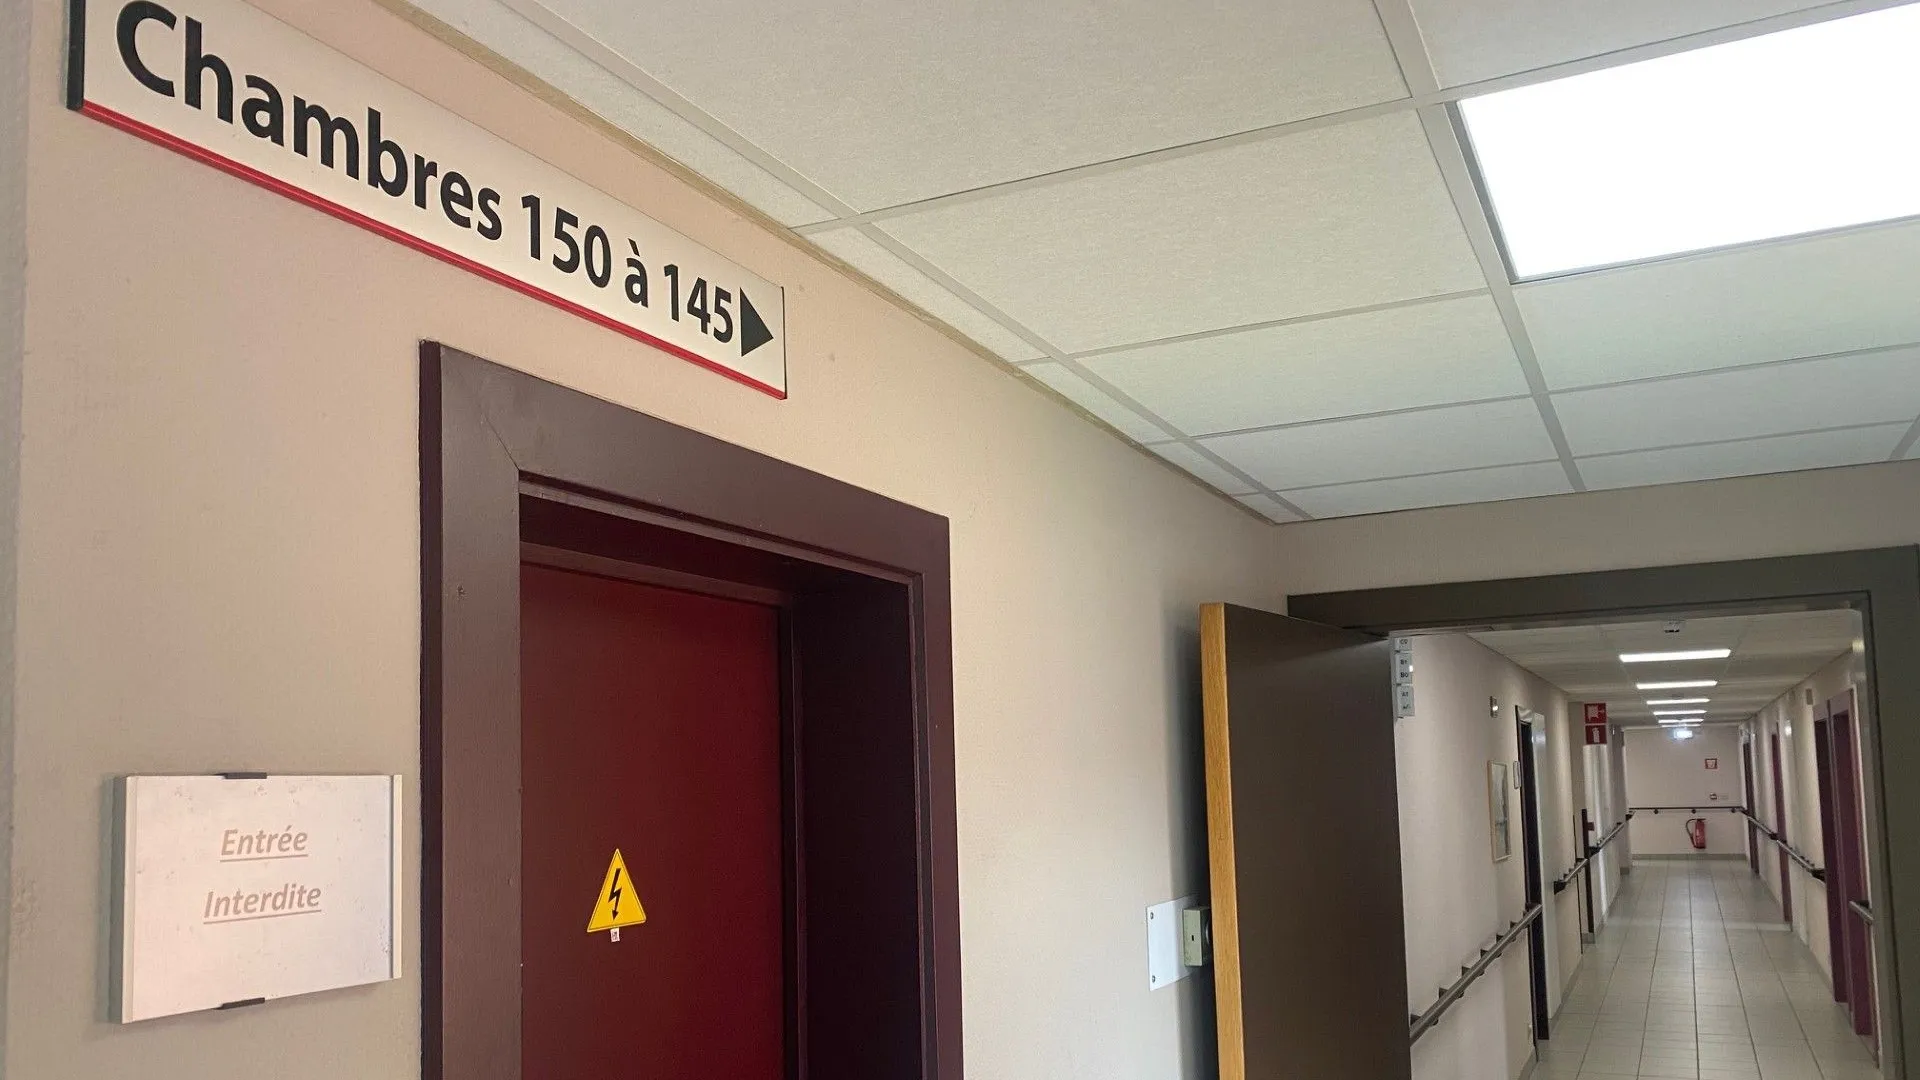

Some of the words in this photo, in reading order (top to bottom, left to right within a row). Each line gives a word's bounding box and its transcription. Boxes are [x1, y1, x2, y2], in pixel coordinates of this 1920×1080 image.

[116, 0, 503, 241] Chambres
[521, 194, 612, 289] 150
[624, 237, 649, 308] à
[663, 263, 734, 344] 145
[220, 825, 309, 857] Entrée
[203, 883, 322, 919] Interdite
